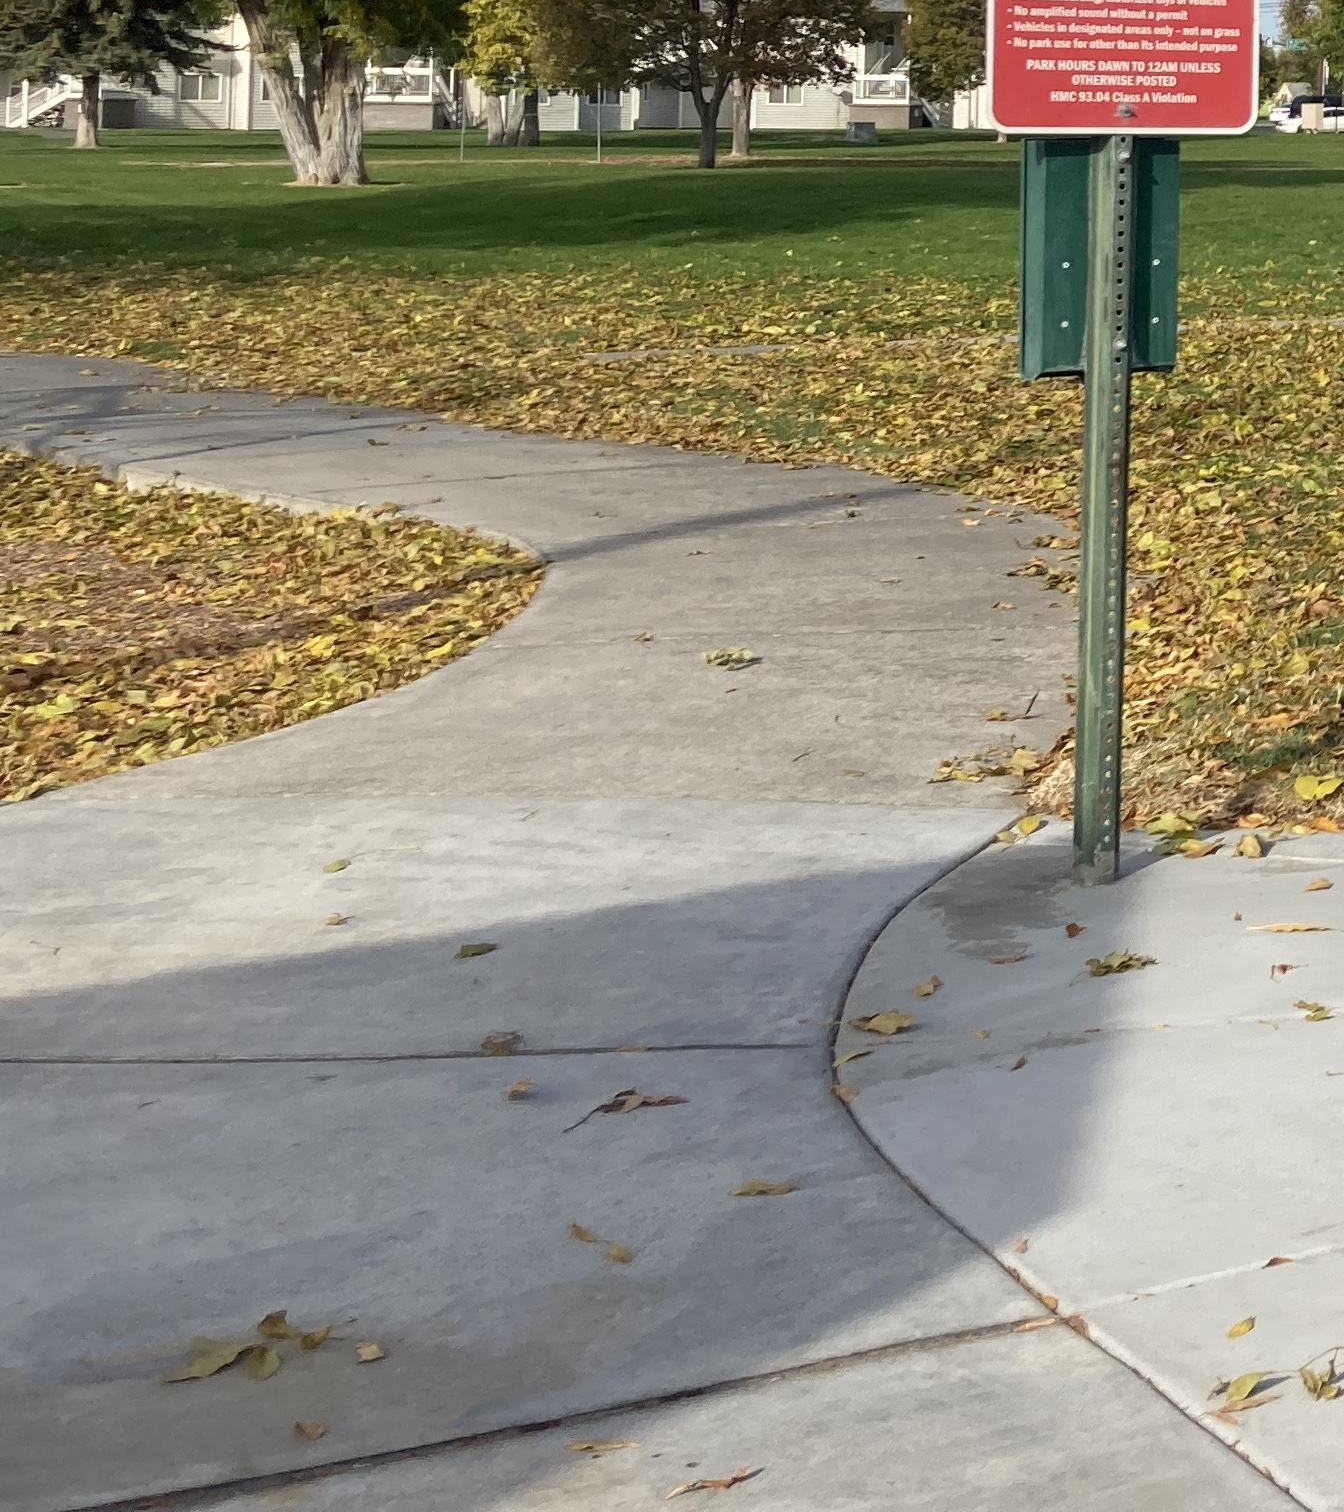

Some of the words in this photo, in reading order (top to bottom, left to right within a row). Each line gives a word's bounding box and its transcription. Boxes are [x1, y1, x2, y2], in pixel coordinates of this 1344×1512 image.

[1026, 59, 1055, 71] PARK
[1057, 60, 1096, 71] HOURS
[1098, 60, 1129, 72] DAWN
[1131, 61, 1145, 72] TO
[1148, 61, 1178, 72] 12AM
[1180, 61, 1220, 73] UNLESS
[1071, 75, 1134, 86] OTHERWISE
[1135, 75, 1176, 86] POSTED
[1050, 91, 1077, 102] HMC
[1078, 91, 1110, 103] 93.04
[1111, 92, 1140, 103] Class
[1142, 92, 1150, 103] A
[1151, 92, 1197, 103] Violation
